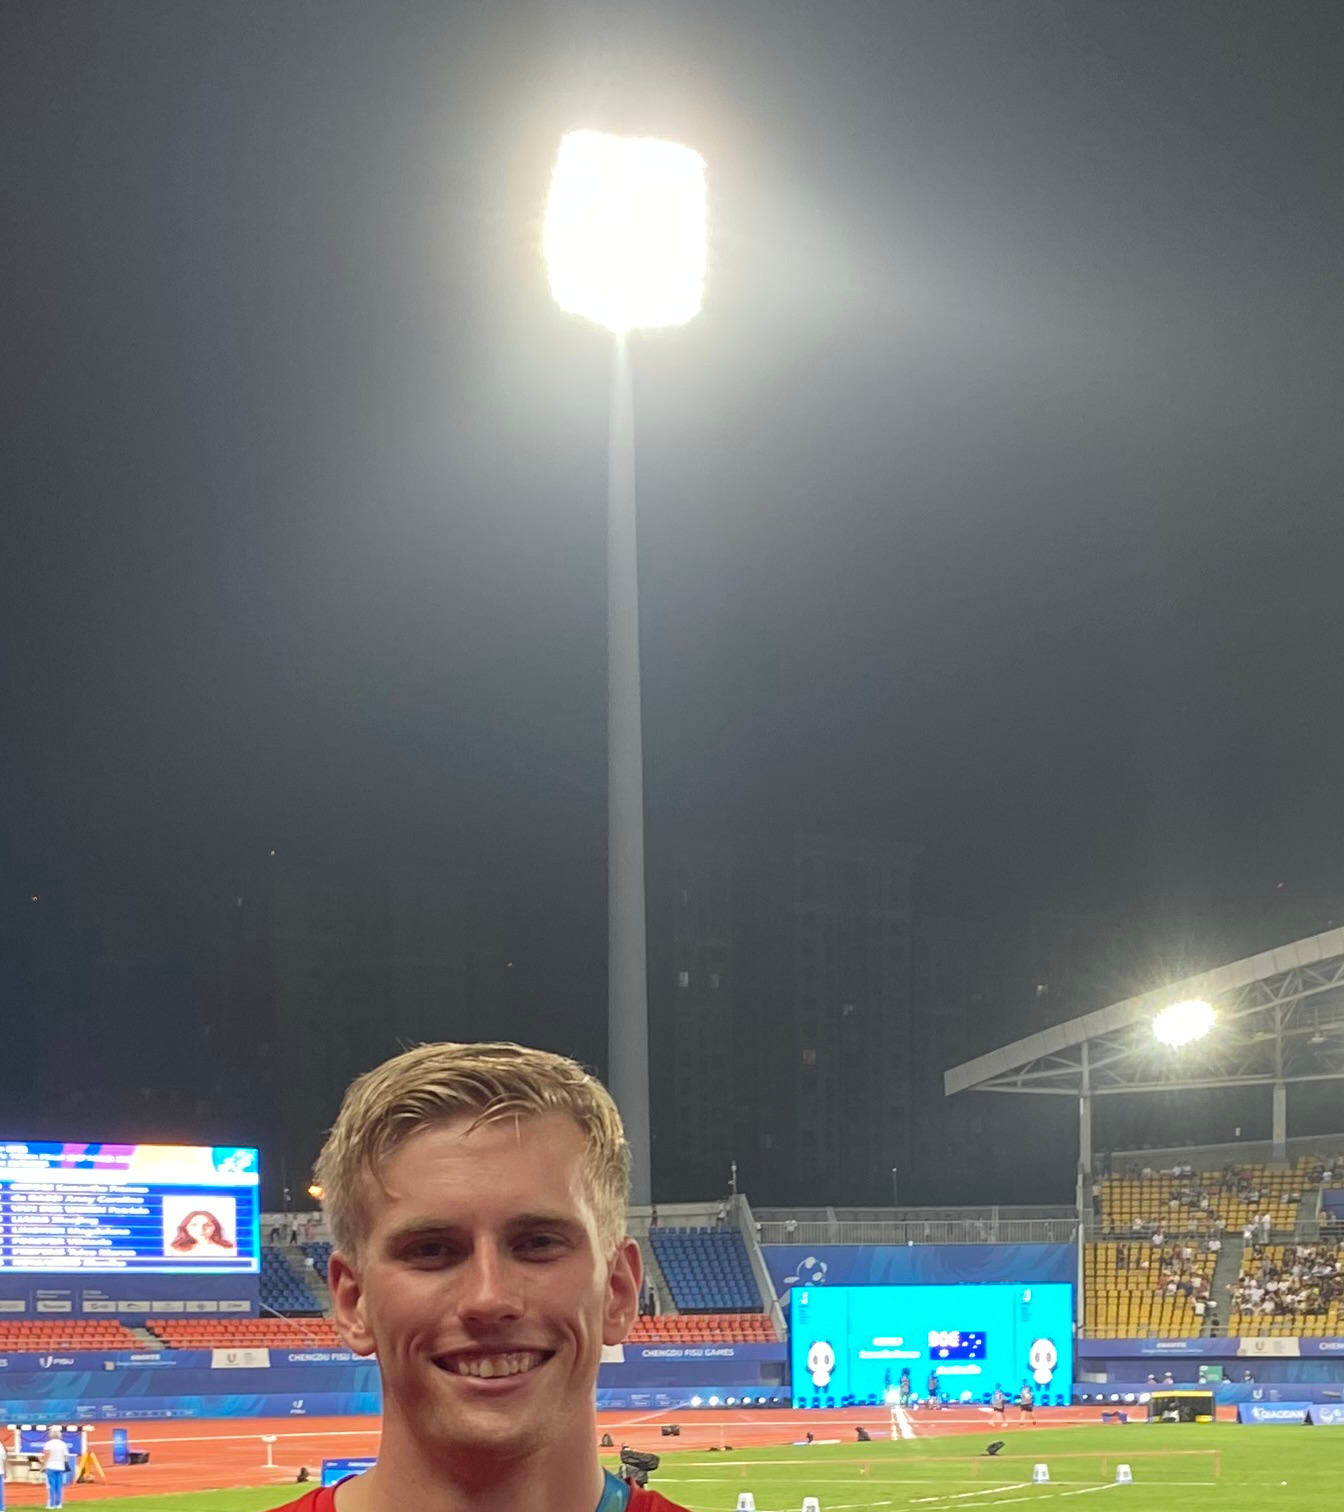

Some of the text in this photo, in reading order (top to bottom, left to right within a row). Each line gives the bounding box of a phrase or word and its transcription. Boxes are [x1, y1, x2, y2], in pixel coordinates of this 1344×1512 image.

[288, 1353, 330, 1362] CHENGDU
[331, 1353, 351, 1361] FISU
[642, 1348, 735, 1358] CHENGDU FISU GAMES
